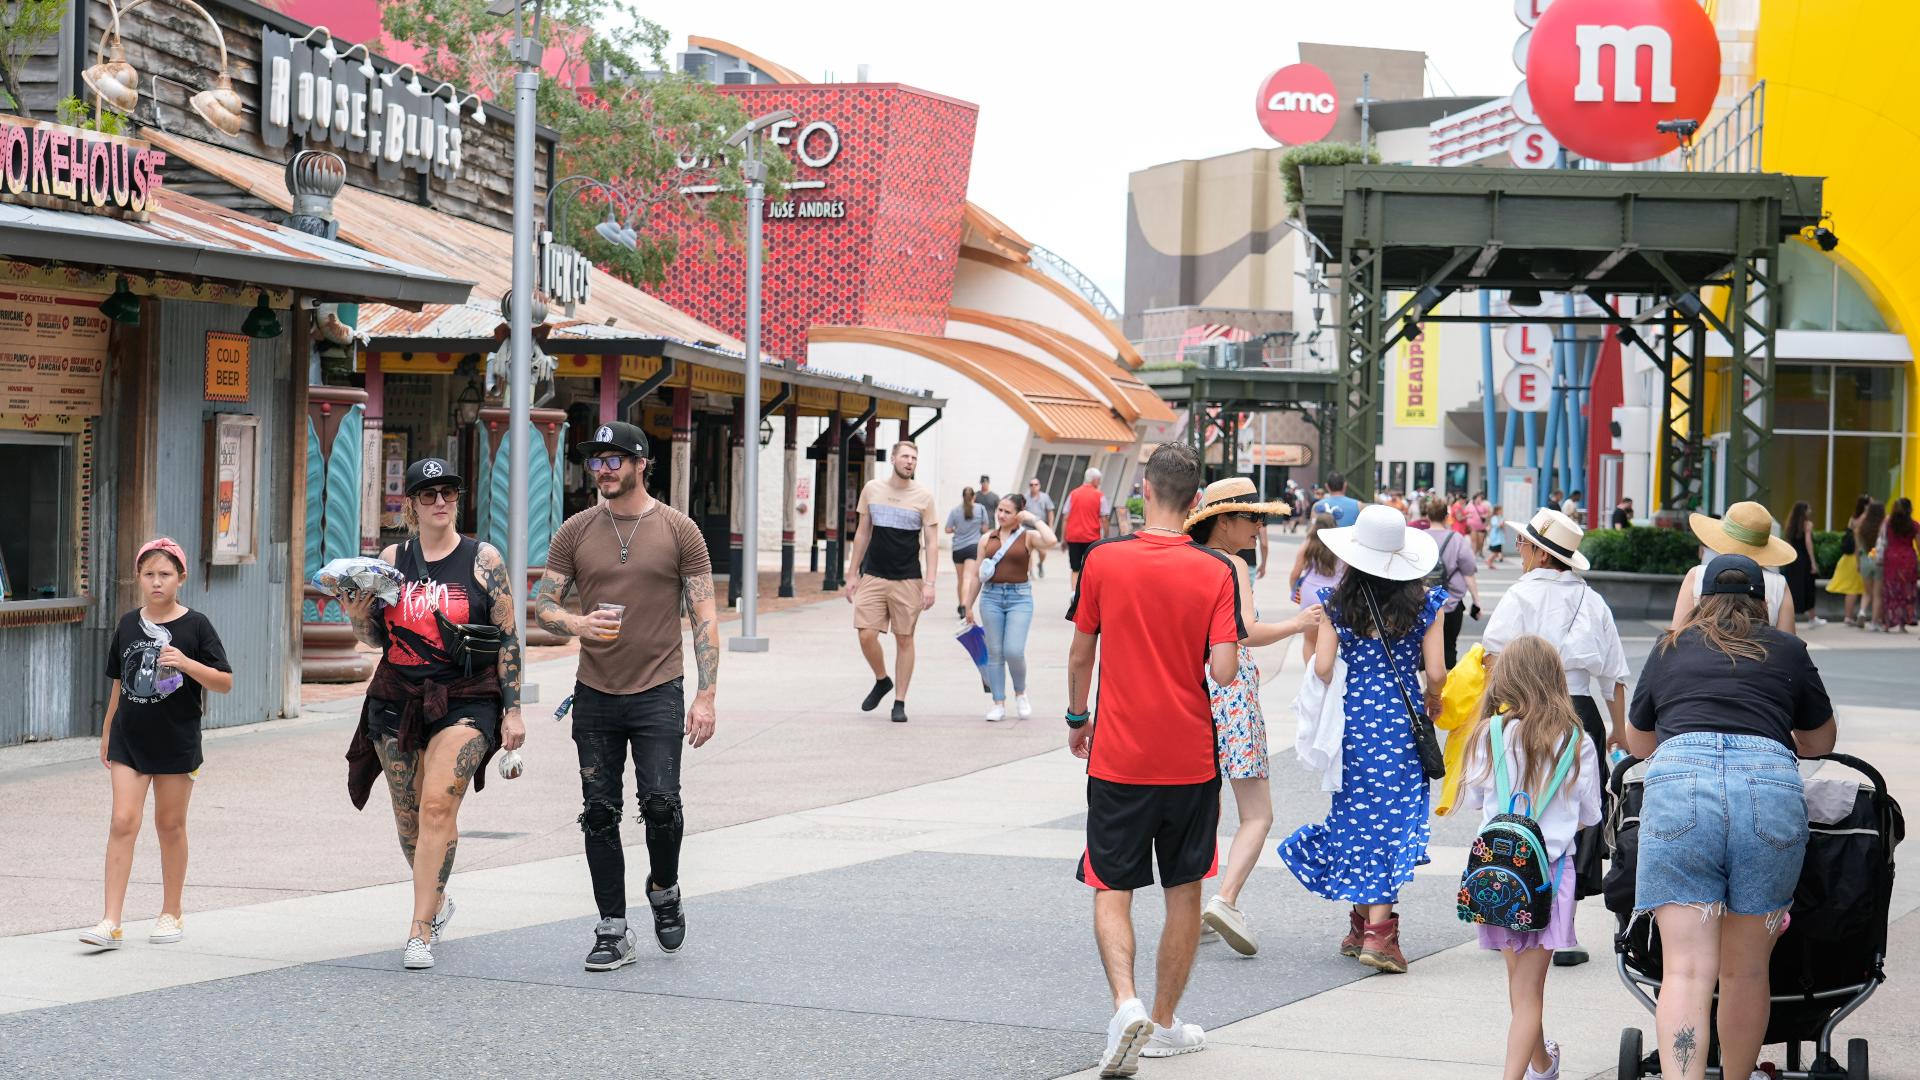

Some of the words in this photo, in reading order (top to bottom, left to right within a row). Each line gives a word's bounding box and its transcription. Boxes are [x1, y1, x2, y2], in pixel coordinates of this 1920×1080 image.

[1574, 24, 1676, 102] m
[270, 55, 367, 138] HOUSE
[384, 103, 462, 170] BLUES
[768, 201, 796, 219] JOSÉ
[797, 200, 845, 219] ANDRÉS
[540, 231, 593, 302] TICKETS
[19, 294, 53, 304] COCKTAILS
[217, 347, 240, 364] COLD
[216, 370, 240, 386] BEER
